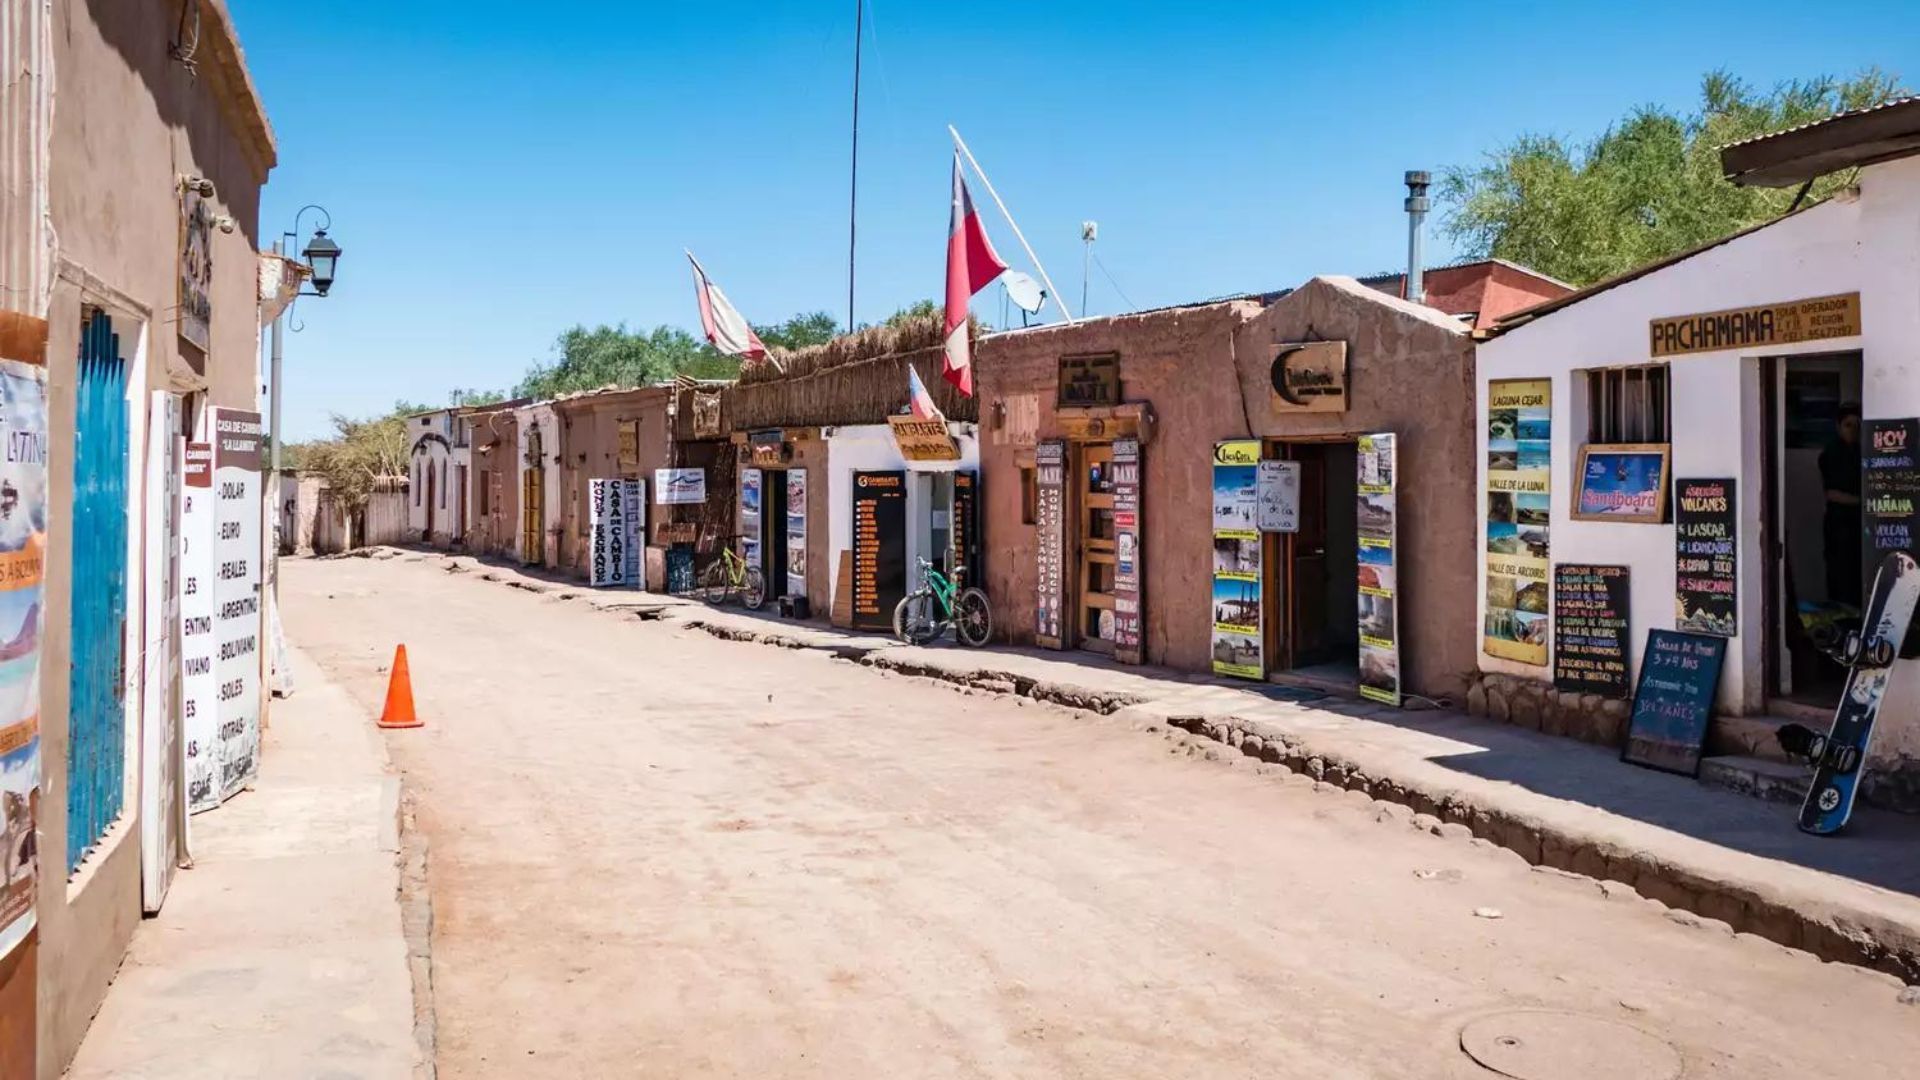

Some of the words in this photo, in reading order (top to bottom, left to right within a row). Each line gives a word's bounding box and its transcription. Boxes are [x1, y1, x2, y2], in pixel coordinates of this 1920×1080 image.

[1802, 299, 1848, 314] OPERADOR
[1652, 309, 1774, 353] PACHAMAMA
[1493, 395, 1521, 406] LAGUNA
[1521, 394, 1543, 405] CEJAR
[217, 419, 232, 432] CASA
[233, 421, 242, 433] DE
[1873, 429, 1907, 448] HOY
[222, 482, 245, 499] DOLAR
[1489, 480, 1508, 491] VALLE
[1508, 481, 1517, 491] DE
[1517, 481, 1525, 491] LA
[1526, 481, 1545, 491] LUNA
[594, 481, 605, 517] MONEY
[610, 481, 621, 517] CASA
[1585, 488, 1657, 507] Sandboard
[1681, 497, 1727, 512] VOLCANES
[1866, 494, 1914, 512] MAÑANA
[1039, 489, 1047, 526] CASA
[1049, 489, 1058, 526] MONEY
[221, 522, 240, 540] EURO
[1687, 522, 1726, 537] LASCAR
[595, 524, 606, 582] EXCHANGE
[611, 527, 622, 581] CAMBIO
[221, 560, 246, 579] REALES
[1038, 536, 1047, 592] CAMBIO
[1049, 534, 1058, 594] EXCHANGE
[1487, 563, 1504, 575] VALLE
[1505, 565, 1516, 576] DEL
[1712, 561, 1732, 573] TOCO
[1562, 583, 1582, 591] SALAR
[221, 597, 257, 620] ARGENTINO
[221, 635, 255, 661] BOLIVIANO
[1653, 653, 1661, 665] 3
[221, 678, 243, 701] SOLES
